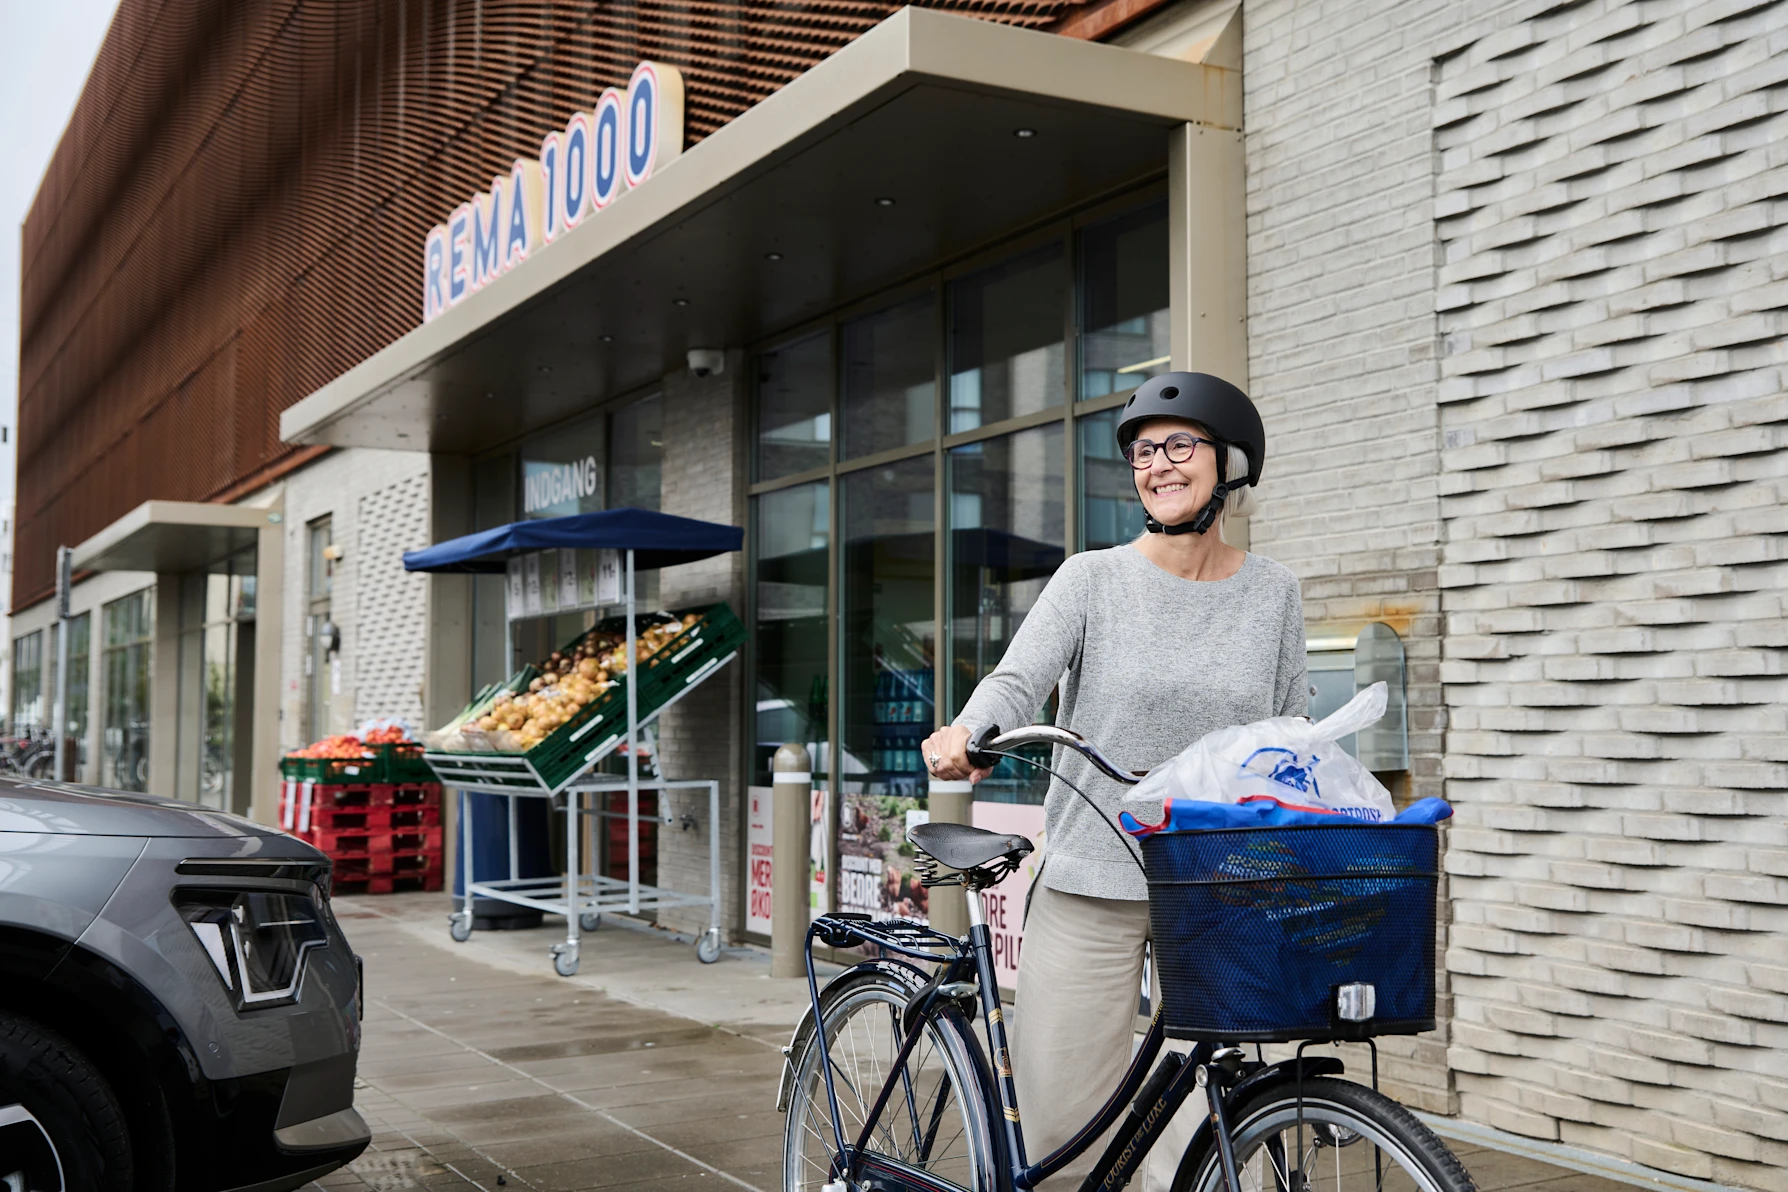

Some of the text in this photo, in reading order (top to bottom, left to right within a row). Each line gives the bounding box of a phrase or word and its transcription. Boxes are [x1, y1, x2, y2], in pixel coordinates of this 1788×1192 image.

[424, 62, 657, 322] REMA 1000
[525, 456, 596, 513] INDGANG
[842, 870, 881, 908] BEDRE
[994, 933, 1022, 970] PIL
[1104, 1138, 1136, 1190] TOURIST
[1142, 1096, 1167, 1133] LUXE
